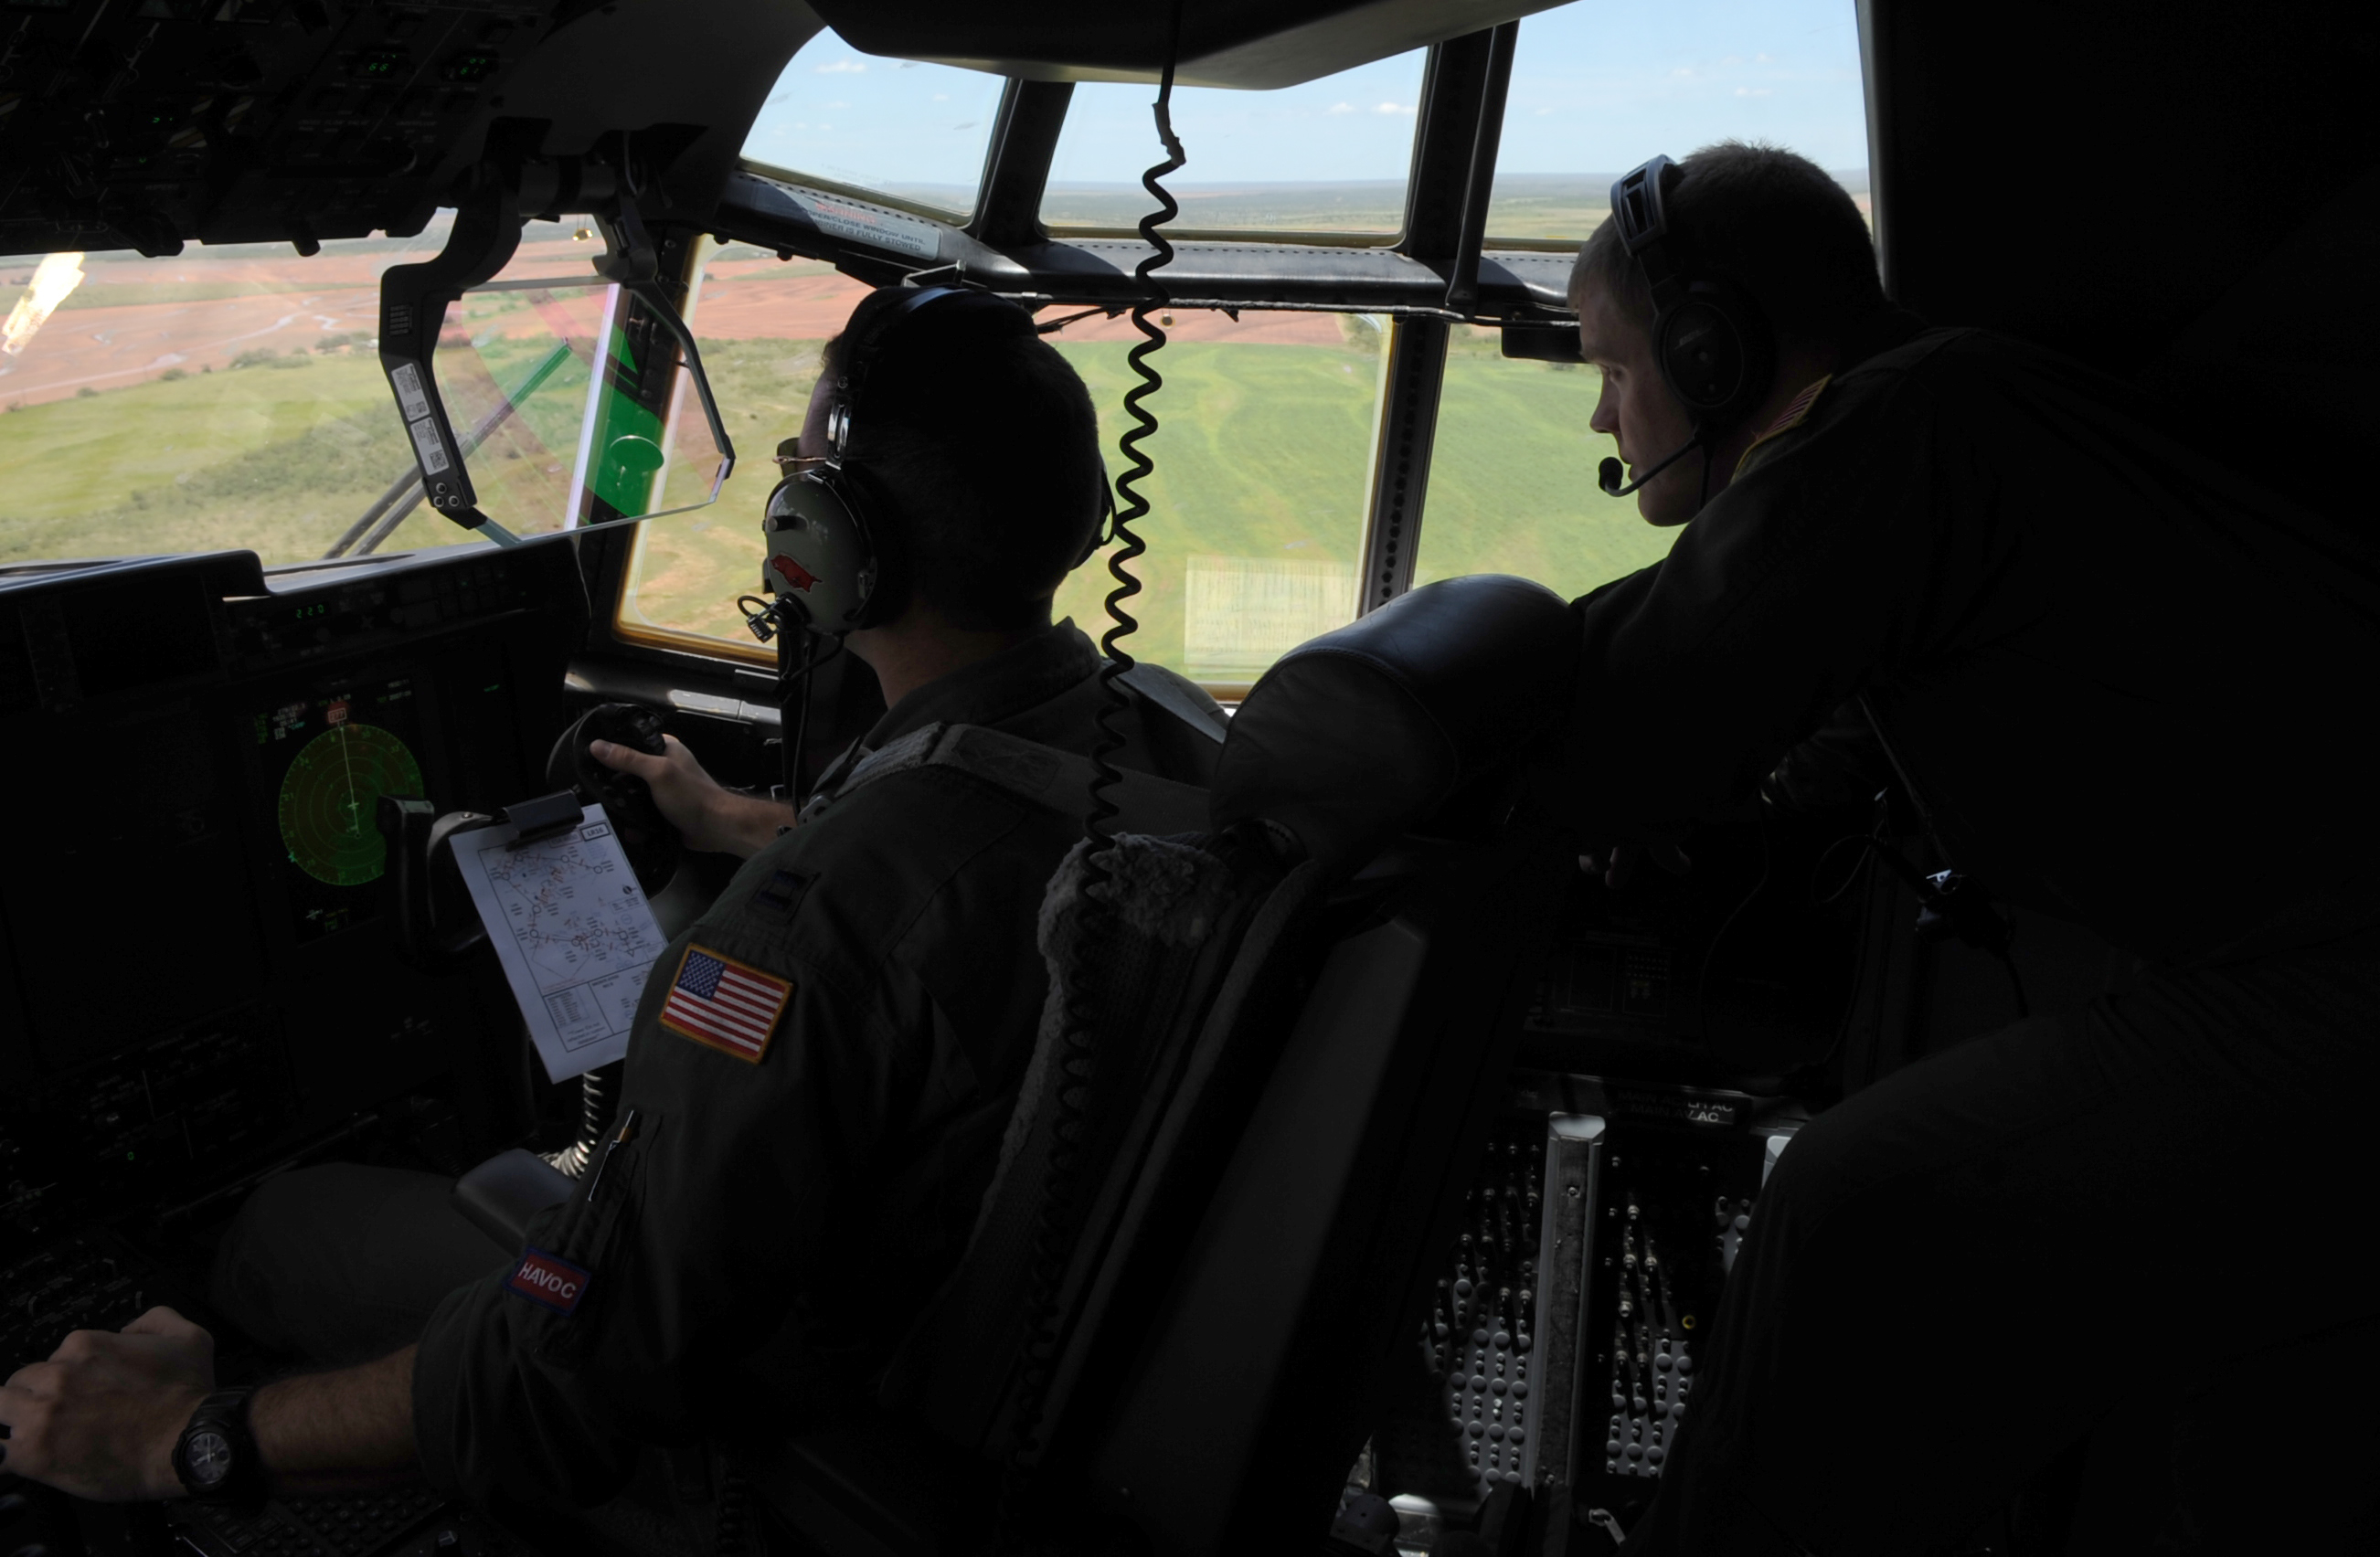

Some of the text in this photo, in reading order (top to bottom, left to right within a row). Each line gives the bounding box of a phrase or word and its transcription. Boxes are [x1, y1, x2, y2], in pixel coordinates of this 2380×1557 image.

[815, 201, 877, 224] WARNING
[856, 229, 884, 241] FULLY
[885, 237, 921, 251] STOWED
[863, 224, 899, 238] WINDOW
[518, 1262, 577, 1299] HAVOC
